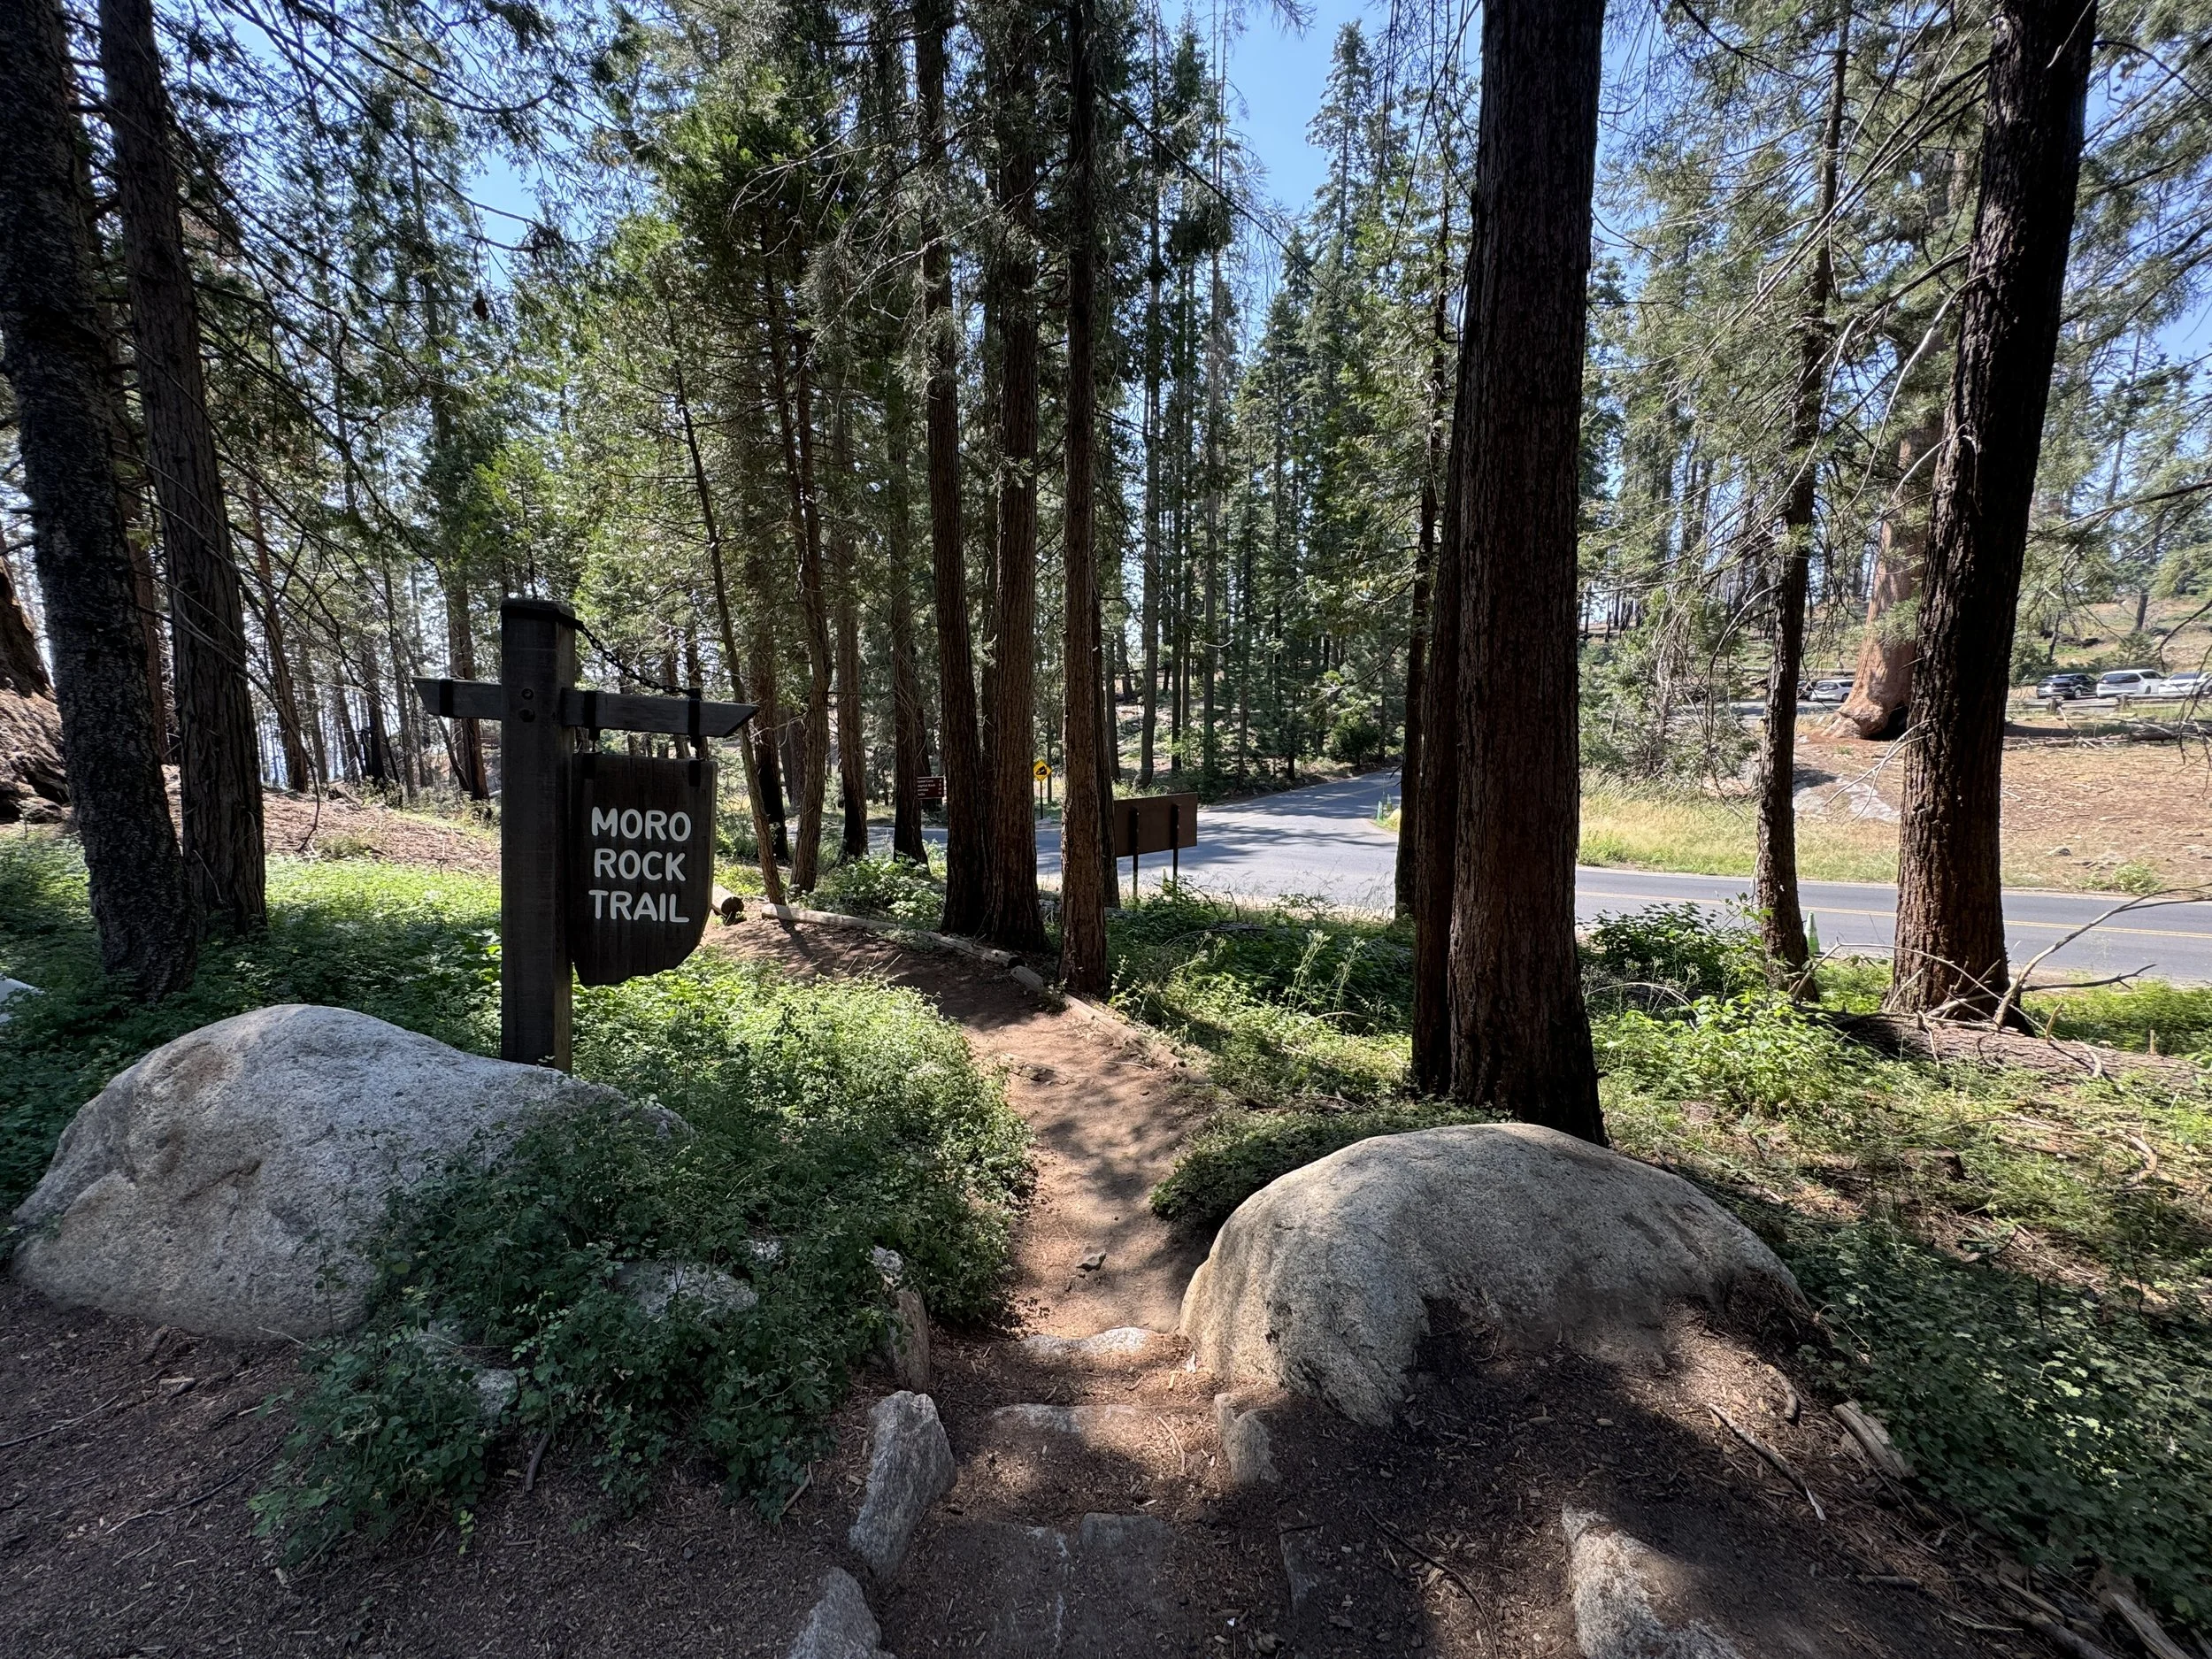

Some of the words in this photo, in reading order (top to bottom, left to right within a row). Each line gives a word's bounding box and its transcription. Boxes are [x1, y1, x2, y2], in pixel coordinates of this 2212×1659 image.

[591, 806, 692, 841] MORO
[594, 848, 687, 881] ROCK
[588, 889, 690, 923] TRAIL
